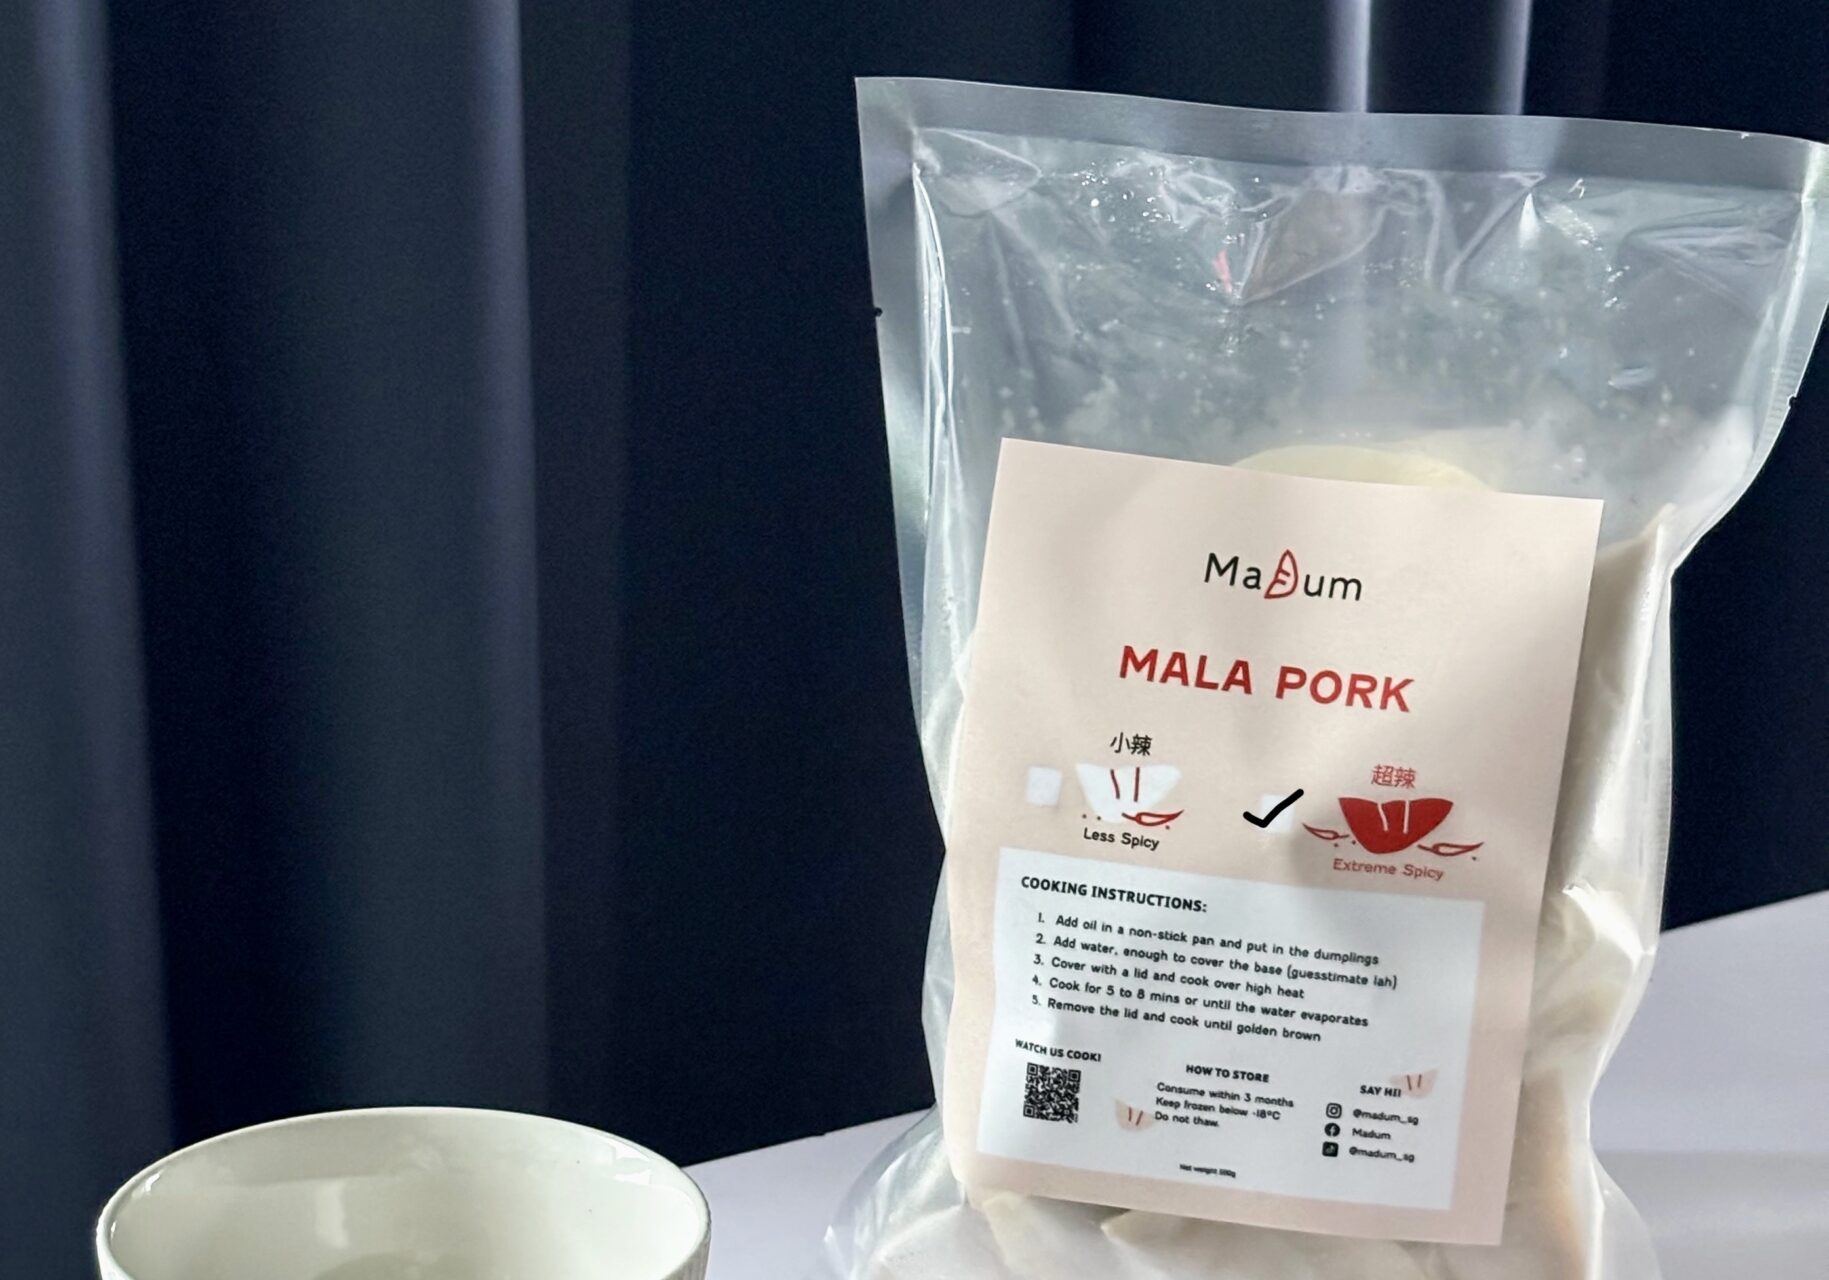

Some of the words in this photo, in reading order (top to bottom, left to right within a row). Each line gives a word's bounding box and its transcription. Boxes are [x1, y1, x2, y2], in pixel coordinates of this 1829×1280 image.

[1120, 645, 1252, 695] MALA
[1275, 665, 1415, 713] PORK
[1110, 732, 1153, 756] 小辣
[1371, 764, 1416, 789] 超辣
[1083, 827, 1114, 845] Less
[1121, 831, 1160, 850] Spicy
[1333, 858, 1397, 877] Extreme
[1403, 862, 1444, 881] Spicy
[1021, 876, 1087, 896] COOKING
[1091, 886, 1207, 912] INSTRUCTIONS:
[1055, 915, 1078, 927] Add
[1083, 919, 1097, 931] oil
[1101, 923, 1112, 933] in
[1118, 926, 1124, 935] a
[1129, 927, 1187, 943] non-stick
[1192, 935, 1215, 947] pan
[1220, 939, 1242, 949] and
[1247, 942, 1267, 953] put
[1272, 944, 1284, 955] in
[1289, 946, 1309, 958] the
[1314, 949, 1379, 967] dumplings
[1035, 932, 1046, 944] 2.
[1053, 936, 1076, 949] Add
[1123, 948, 1168, 963] enough
[1173, 953, 1186, 963] to
[1190, 956, 1224, 967] cover
[1229, 959, 1249, 971] the
[1254, 962, 1282, 975] base
[1287, 965, 1368, 985] (guesstimate
[1373, 975, 1397, 990] lah)
[1033, 954, 1044, 966] 3.
[1051, 957, 1085, 971] Cover
[1091, 963, 1116, 975] with
[1122, 969, 1129, 977] a
[1134, 968, 1148, 980] lid
[1153, 971, 1175, 983] and
[1180, 974, 1209, 987] cook
[1214, 980, 1241, 991] over
[1246, 981, 1271, 996] high
[1277, 987, 1304, 999] heat
[1049, 977, 1080, 992] Cook
[1085, 982, 1101, 994] for
[1106, 985, 1115, 996] 5
[1120, 988, 1132, 999] to
[1137, 989, 1145, 1000] 8
[1150, 992, 1180, 1004] mins
[1185, 997, 1198, 1005] or
[1203, 999, 1230, 1010] until
[1236, 1001, 1255, 1013] the
[1261, 1006, 1295, 1018] water
[1301, 1011, 1368, 1027] evaporates
[1047, 998, 1095, 1014] Remove
[1100, 1005, 1119, 1017] the
[1124, 1008, 1138, 1019] lid
[1143, 1011, 1165, 1022] and
[1170, 1014, 1199, 1027] cook
[1204, 1020, 1232, 1031] until
[1237, 1023, 1277, 1036] golden
[1283, 1028, 1321, 1042] brown
[1015, 1039, 1047, 1054] WATCH
[1050, 1048, 1064, 1057] US
[1186, 1064, 1212, 1076] HOW
[1215, 1068, 1230, 1078] TO
[1232, 1070, 1269, 1083] STORE
[1157, 1082, 1205, 1096] Consume
[1209, 1090, 1240, 1101] within
[1244, 1093, 1251, 1102] 3
[1255, 1096, 1294, 1107] months
[1360, 1085, 1382, 1095] SAY
[1155, 1111, 1169, 1121] Do
[1172, 1114, 1189, 1124] not
[1156, 1097, 1180, 1109] Keep
[1184, 1100, 1215, 1112] frozen
[1219, 1104, 1248, 1116] below
[1353, 1108, 1419, 1126] @madum_sg
[1352, 1128, 1391, 1140] Madum
[1349, 1146, 1415, 1163] @madum_sg
